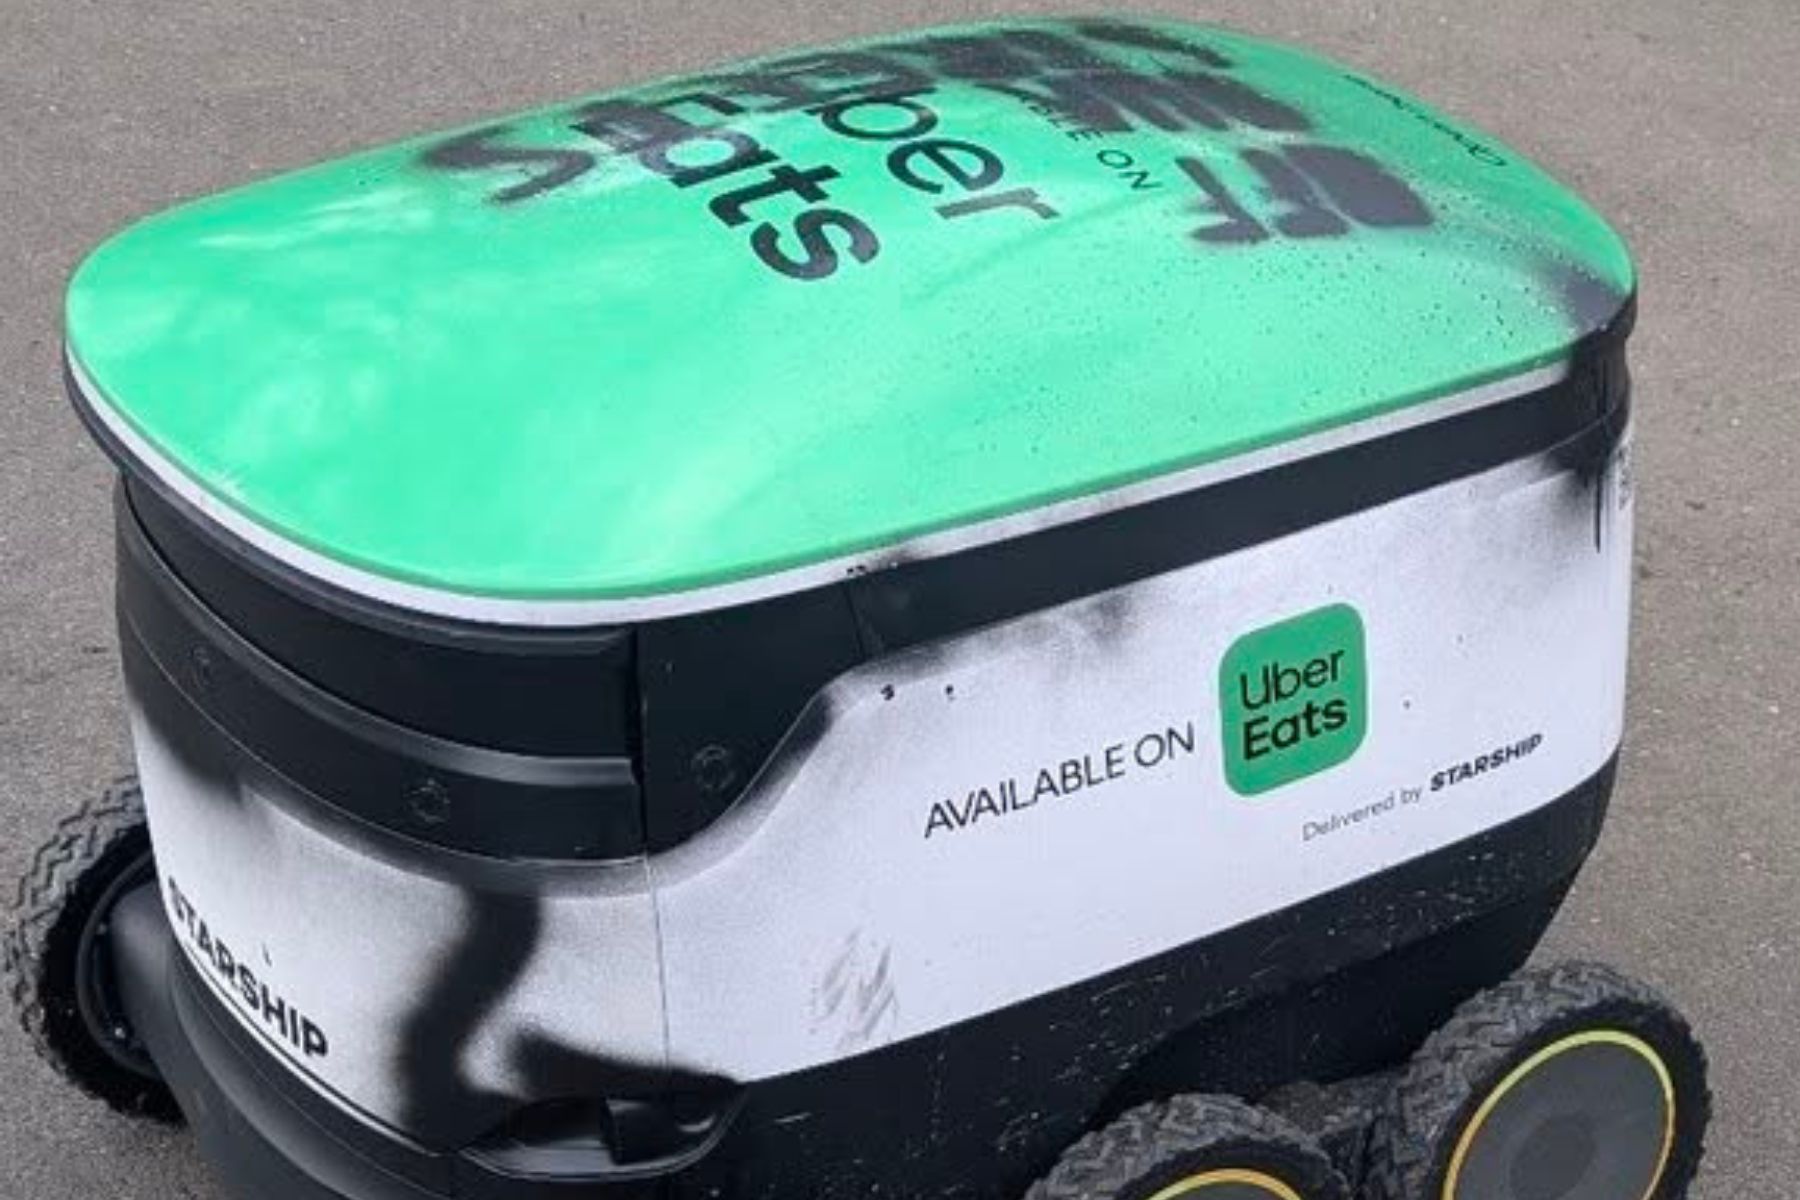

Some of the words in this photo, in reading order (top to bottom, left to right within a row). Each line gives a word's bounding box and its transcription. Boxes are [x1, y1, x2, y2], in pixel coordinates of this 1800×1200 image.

[780, 78, 1062, 219] ber
[1096, 148, 1163, 194] ON
[1238, 644, 1346, 712] Uber
[1241, 692, 1350, 761] Eats
[923, 744, 1125, 839] AVAILABLE
[1134, 720, 1196, 770] ON
[1301, 791, 1396, 842] Delivered
[1400, 786, 1423, 805] by
[1430, 732, 1544, 793] STARSHIP
[168, 873, 329, 1059] STARSHIP
